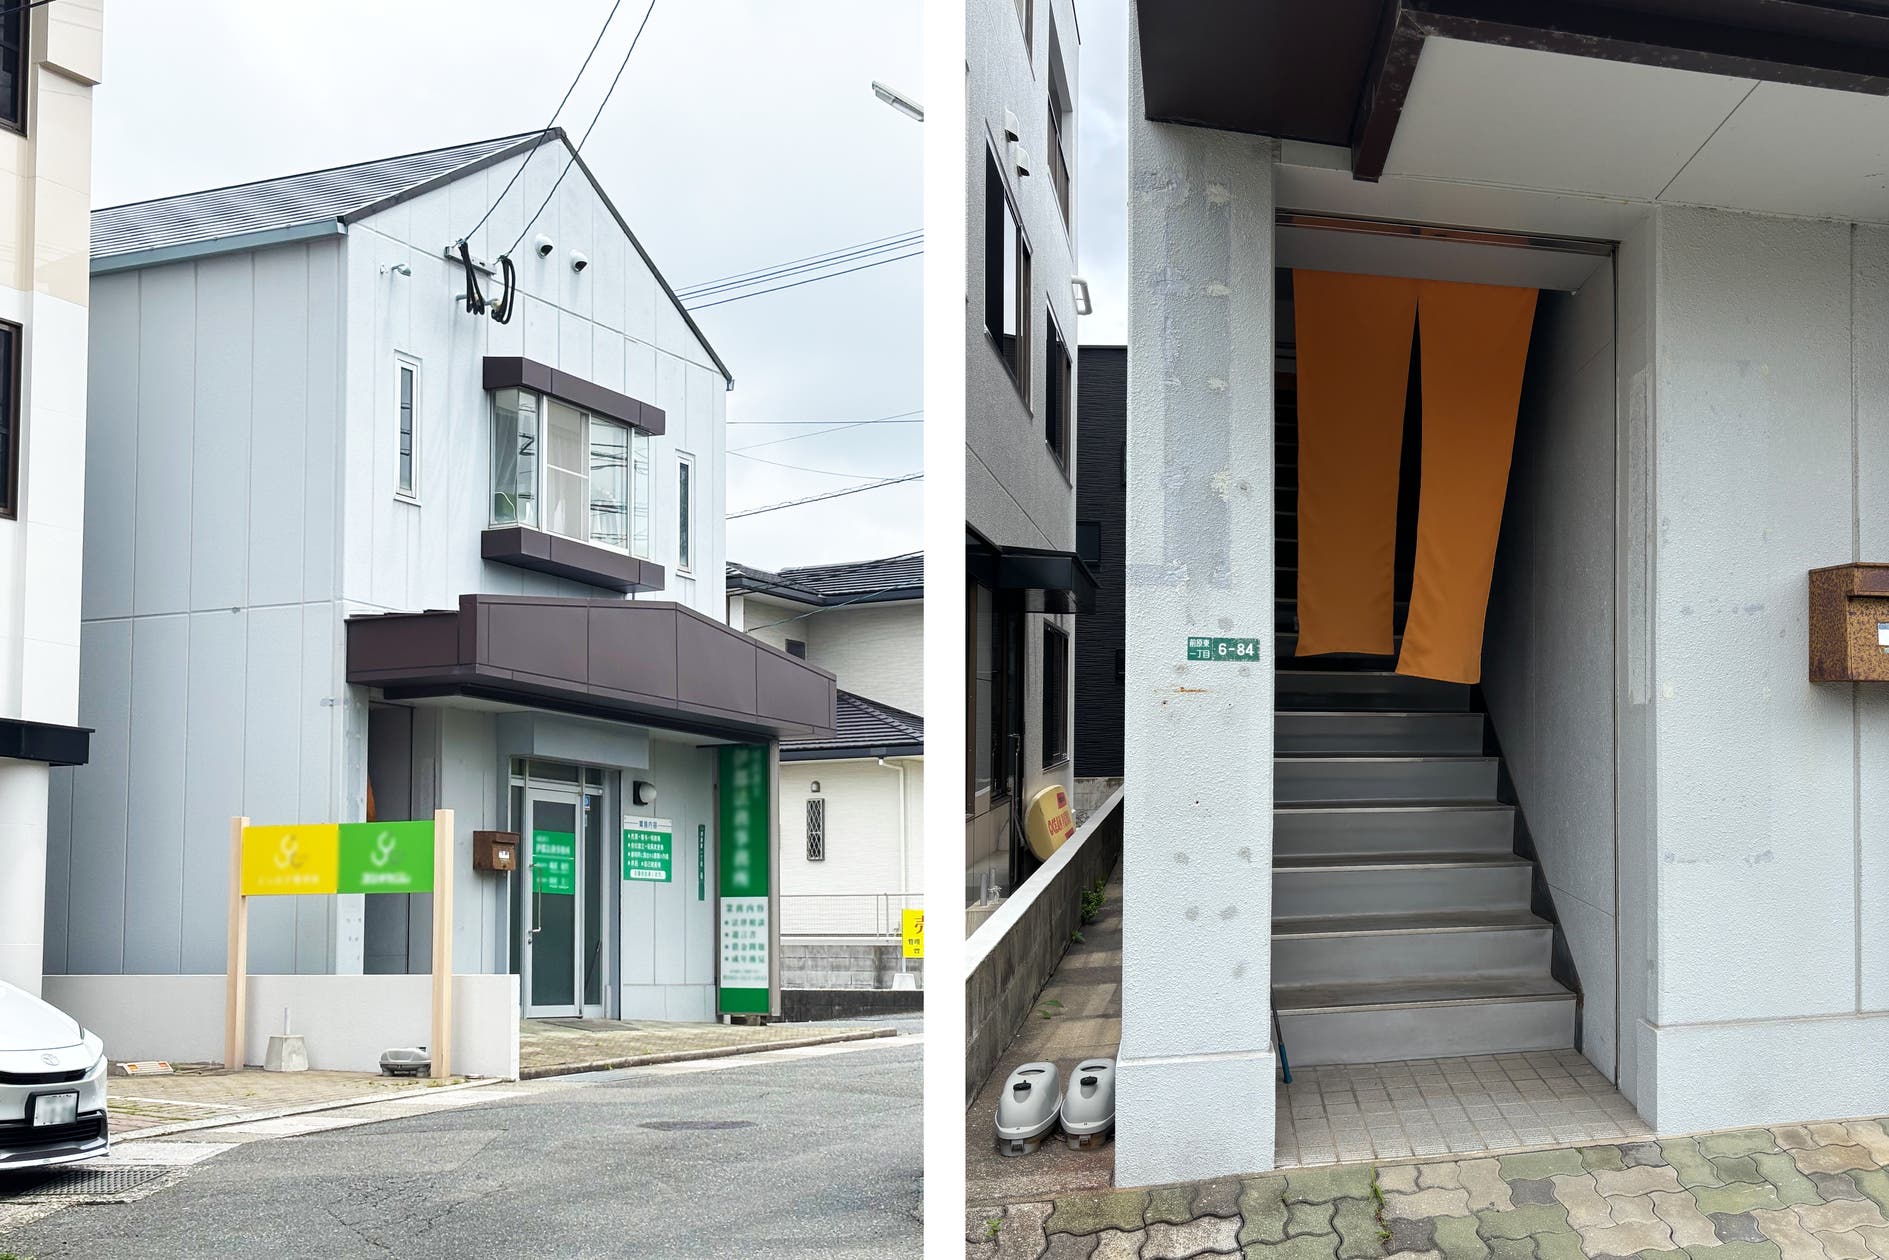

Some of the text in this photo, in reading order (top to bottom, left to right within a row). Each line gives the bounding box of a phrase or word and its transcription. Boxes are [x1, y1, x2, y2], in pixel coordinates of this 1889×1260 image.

[1189, 649, 1210, 659] 一丁目
[1218, 643, 1255, 656] 6-84
